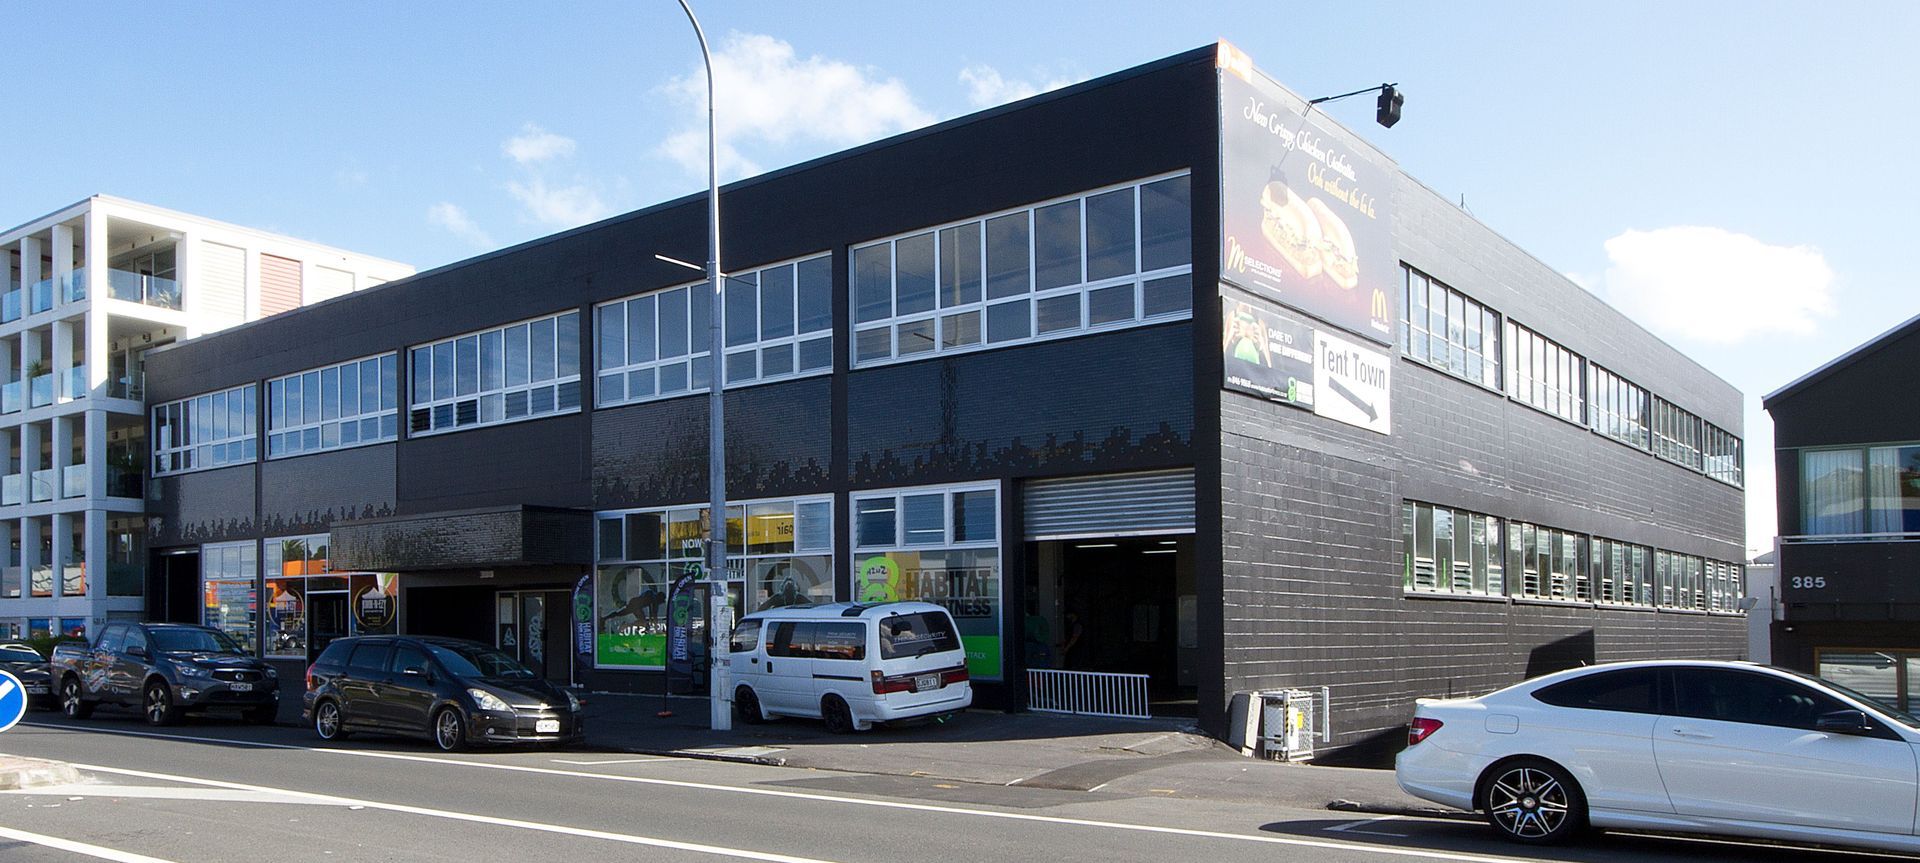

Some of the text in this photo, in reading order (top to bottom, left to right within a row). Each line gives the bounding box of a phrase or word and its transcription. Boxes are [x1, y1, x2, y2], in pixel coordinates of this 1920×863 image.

[1244, 97, 1268, 128] New
[1269, 113, 1295, 151] Crispy
[1296, 130, 1326, 162] Chicken
[1268, 328, 1293, 345] DARE TO
[1320, 340, 1385, 390] Tent Town
[682, 538, 702, 549] NOW
[678, 575, 692, 588] OPEN
[905, 570, 991, 599] HABITAT
[1792, 576, 1826, 589] 385
[583, 622, 592, 654] HABITAT
[680, 627, 688, 660] HABITAT
